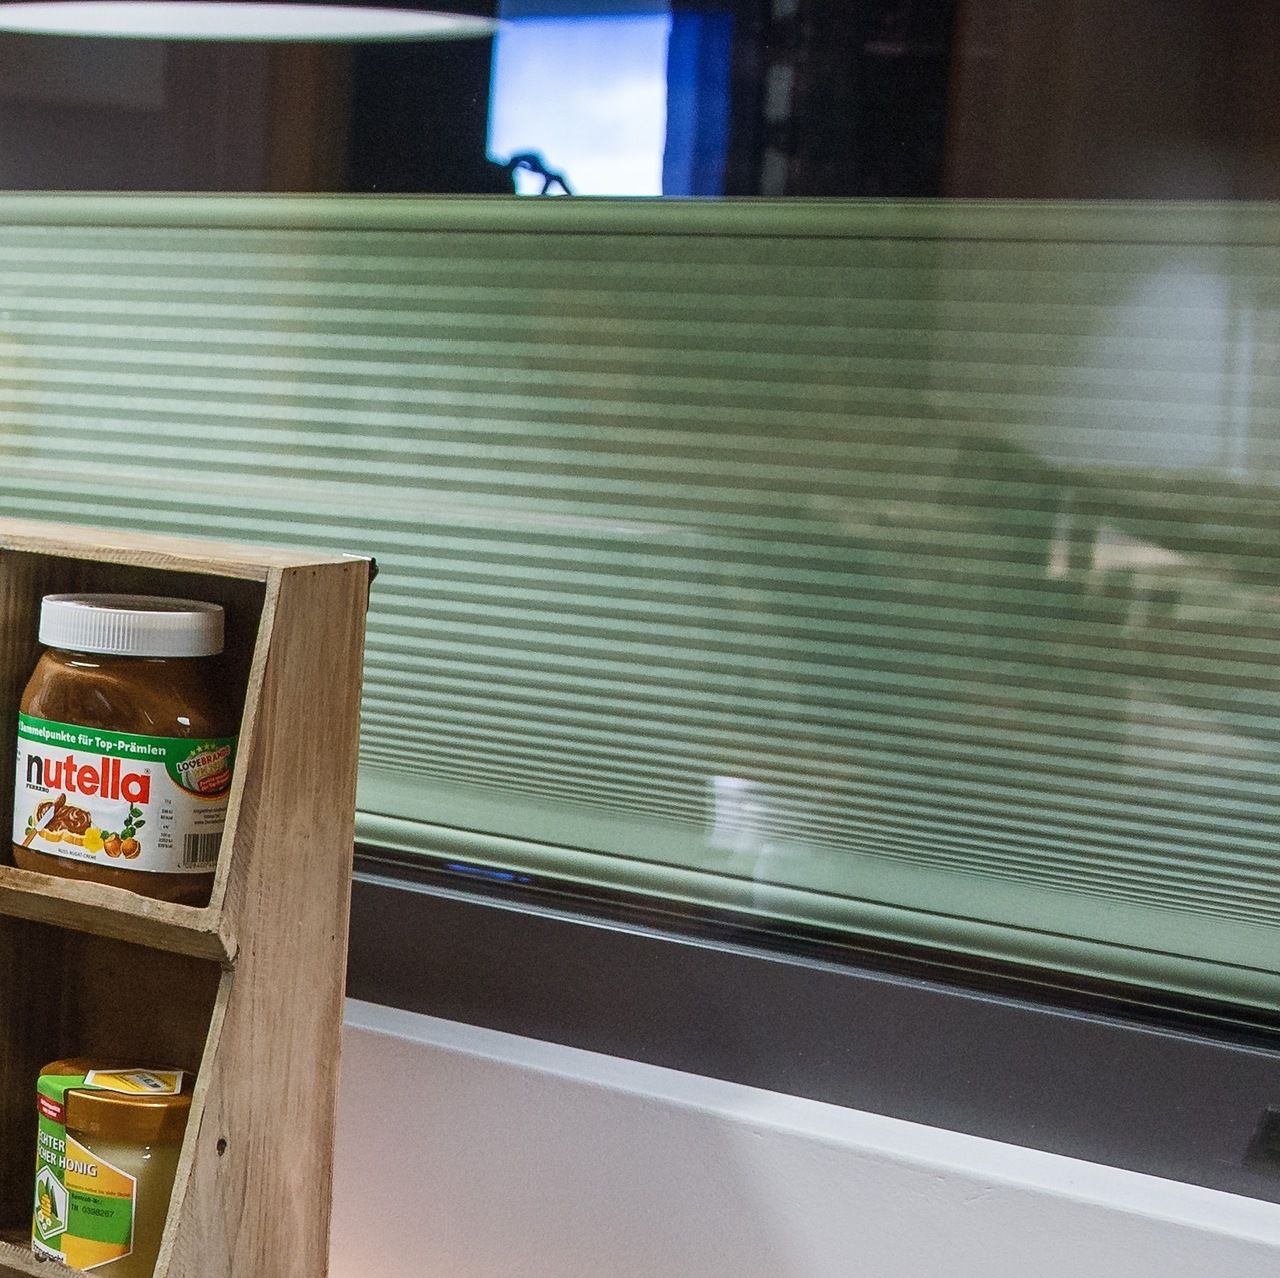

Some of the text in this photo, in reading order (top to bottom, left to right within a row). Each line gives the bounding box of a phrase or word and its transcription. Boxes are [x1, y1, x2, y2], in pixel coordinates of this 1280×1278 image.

[78, 734, 94, 747] für
[95, 737, 167, 756] Top-Prämien
[26, 754, 151, 805] nutella
[58, 1156, 98, 1178] HONIG
